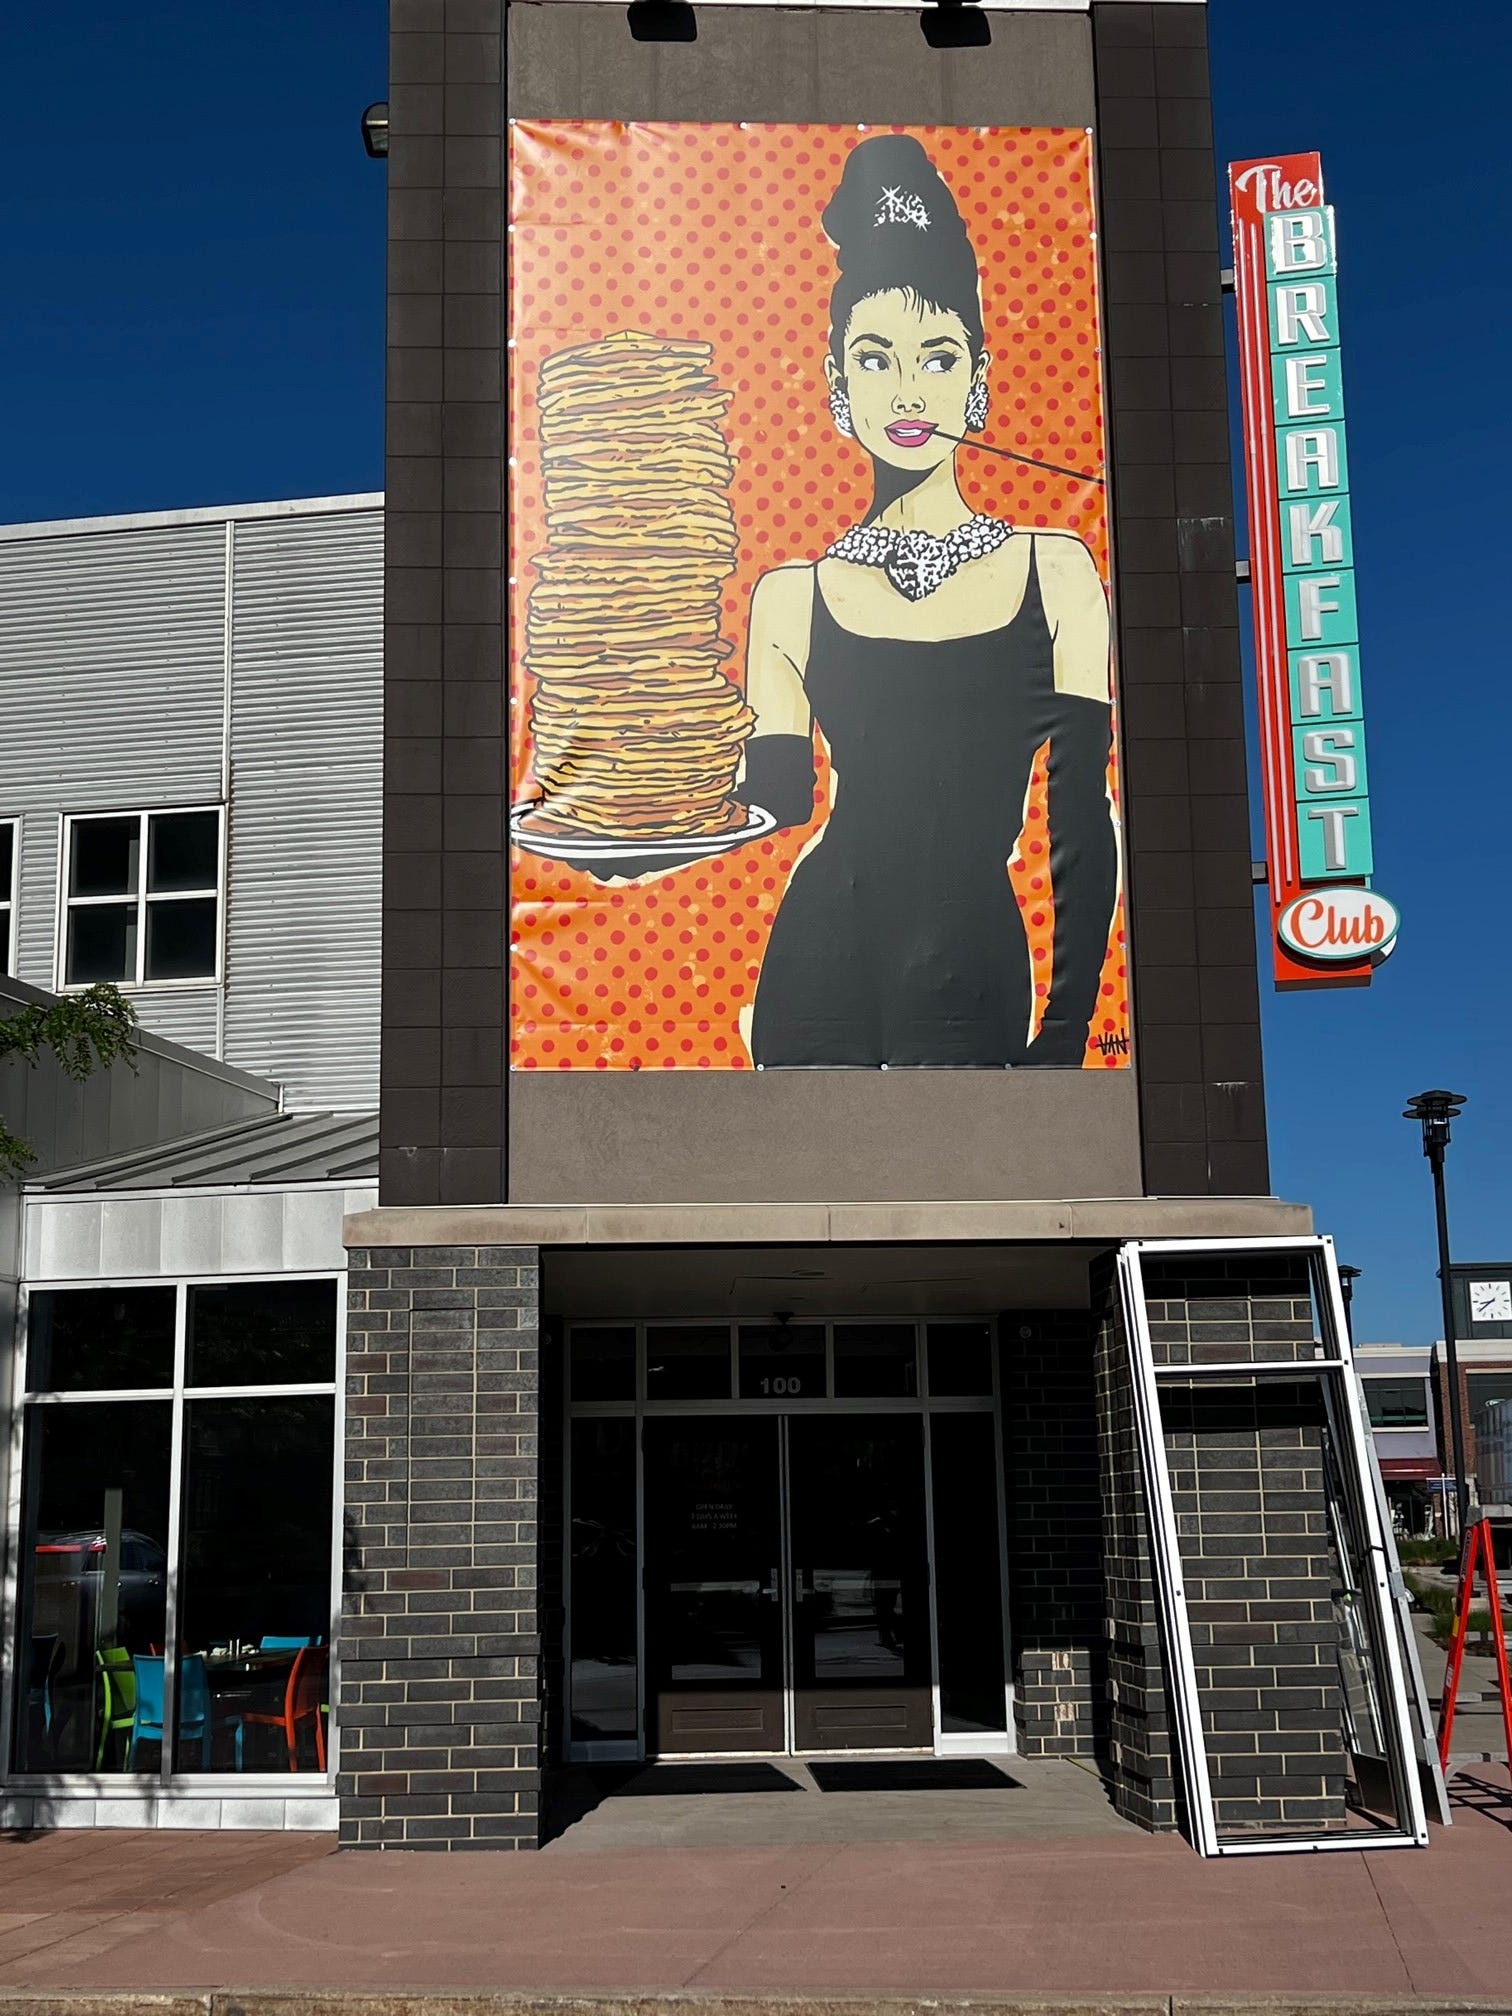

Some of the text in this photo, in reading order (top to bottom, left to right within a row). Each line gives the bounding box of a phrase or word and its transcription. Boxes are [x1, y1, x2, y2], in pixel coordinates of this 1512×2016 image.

[1234, 163, 1317, 214] The
[1270, 211, 1360, 871] BREAKFAST
[1290, 898, 1385, 948] Club
[760, 1377, 801, 1394] 100
